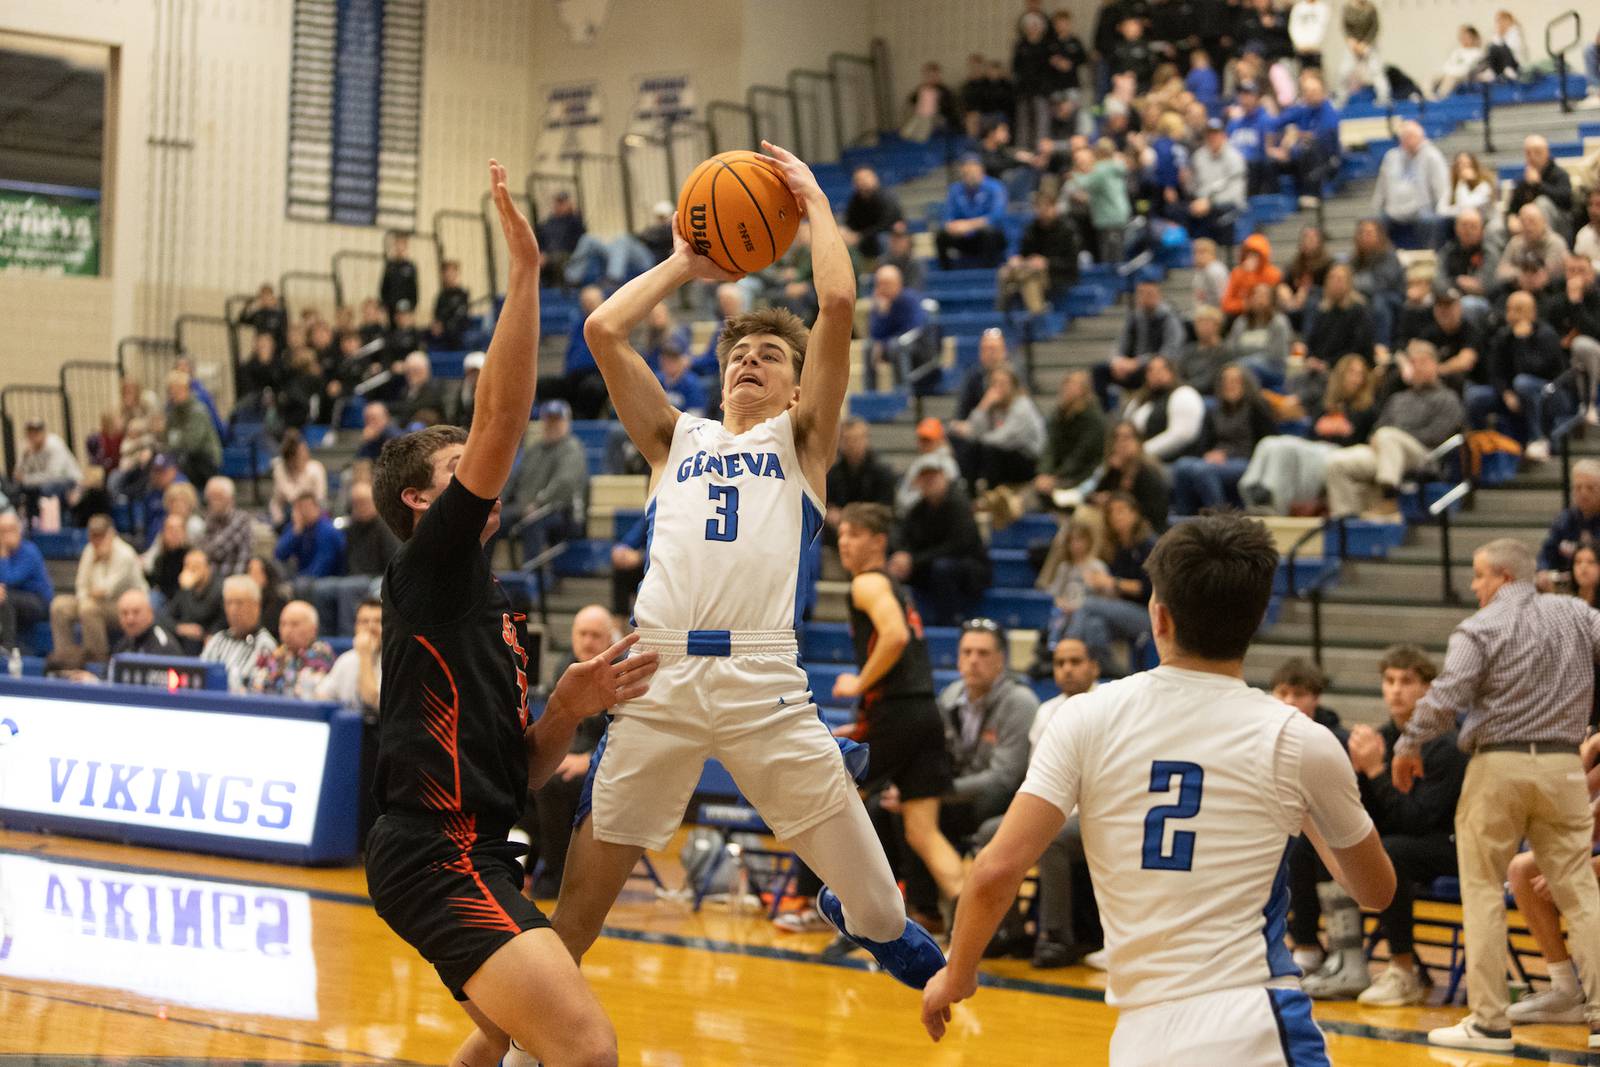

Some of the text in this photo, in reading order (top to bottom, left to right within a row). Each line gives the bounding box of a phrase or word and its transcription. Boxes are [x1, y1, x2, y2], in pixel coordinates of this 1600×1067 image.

[740, 227, 756, 254] NFHS
[676, 450, 785, 482] GENEVA
[705, 483, 739, 542] 3
[49, 757, 296, 829] VIKINGS
[1141, 760, 1204, 872] 2
